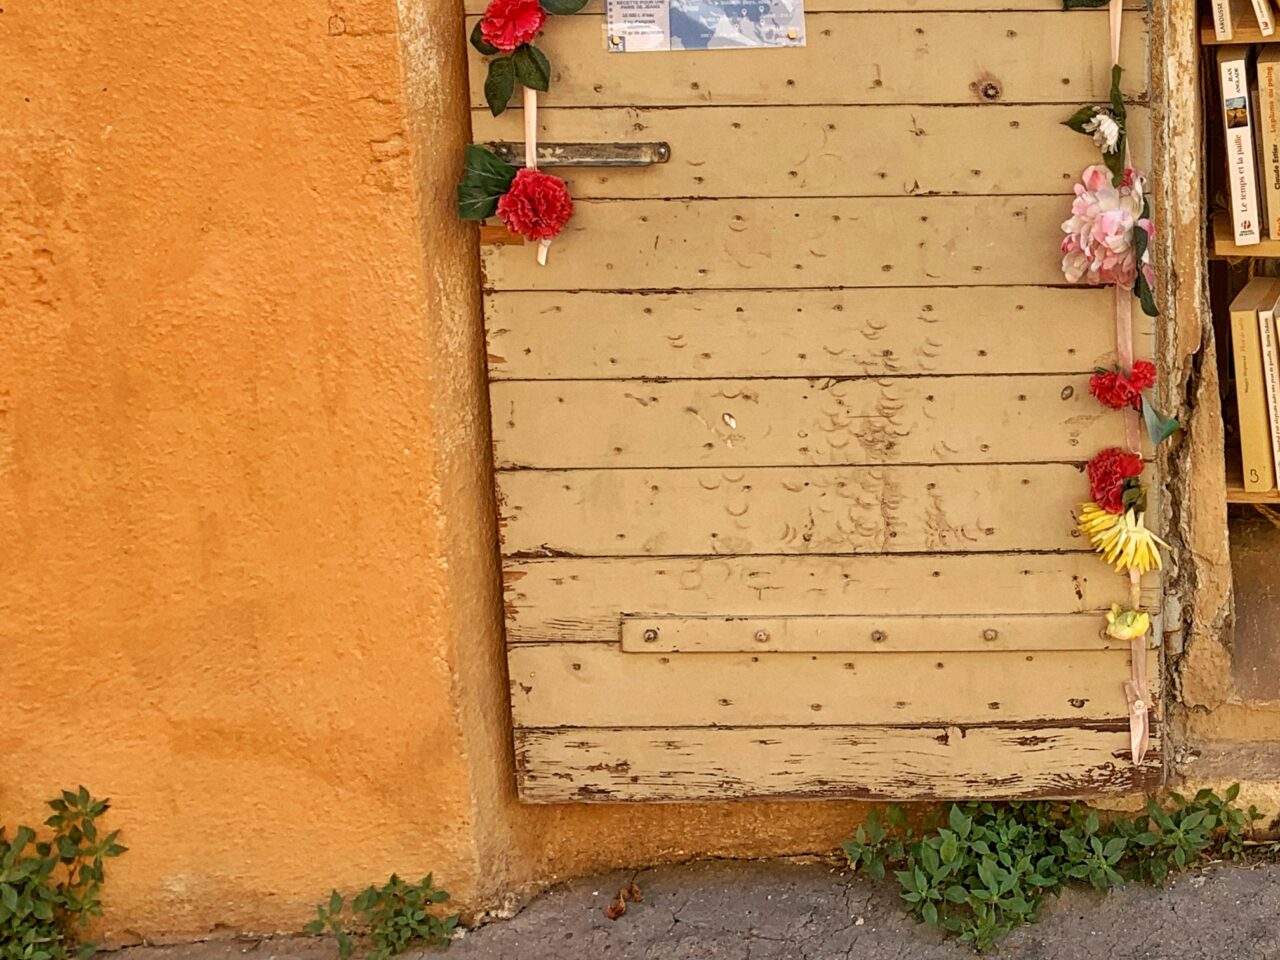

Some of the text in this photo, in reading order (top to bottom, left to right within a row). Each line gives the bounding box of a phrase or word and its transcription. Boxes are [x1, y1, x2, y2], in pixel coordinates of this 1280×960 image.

[1216, 2, 1226, 33] LAROUSSE
[1265, 65, 1274, 87] poing
[1268, 88, 1274, 98] au
[1268, 99, 1277, 123] plume
[1269, 123, 1276, 133] La
[1271, 143, 1279, 163] Estier
[1233, 134, 1248, 212] Le temps et la paille
[1272, 164, 1280, 190] Claude
